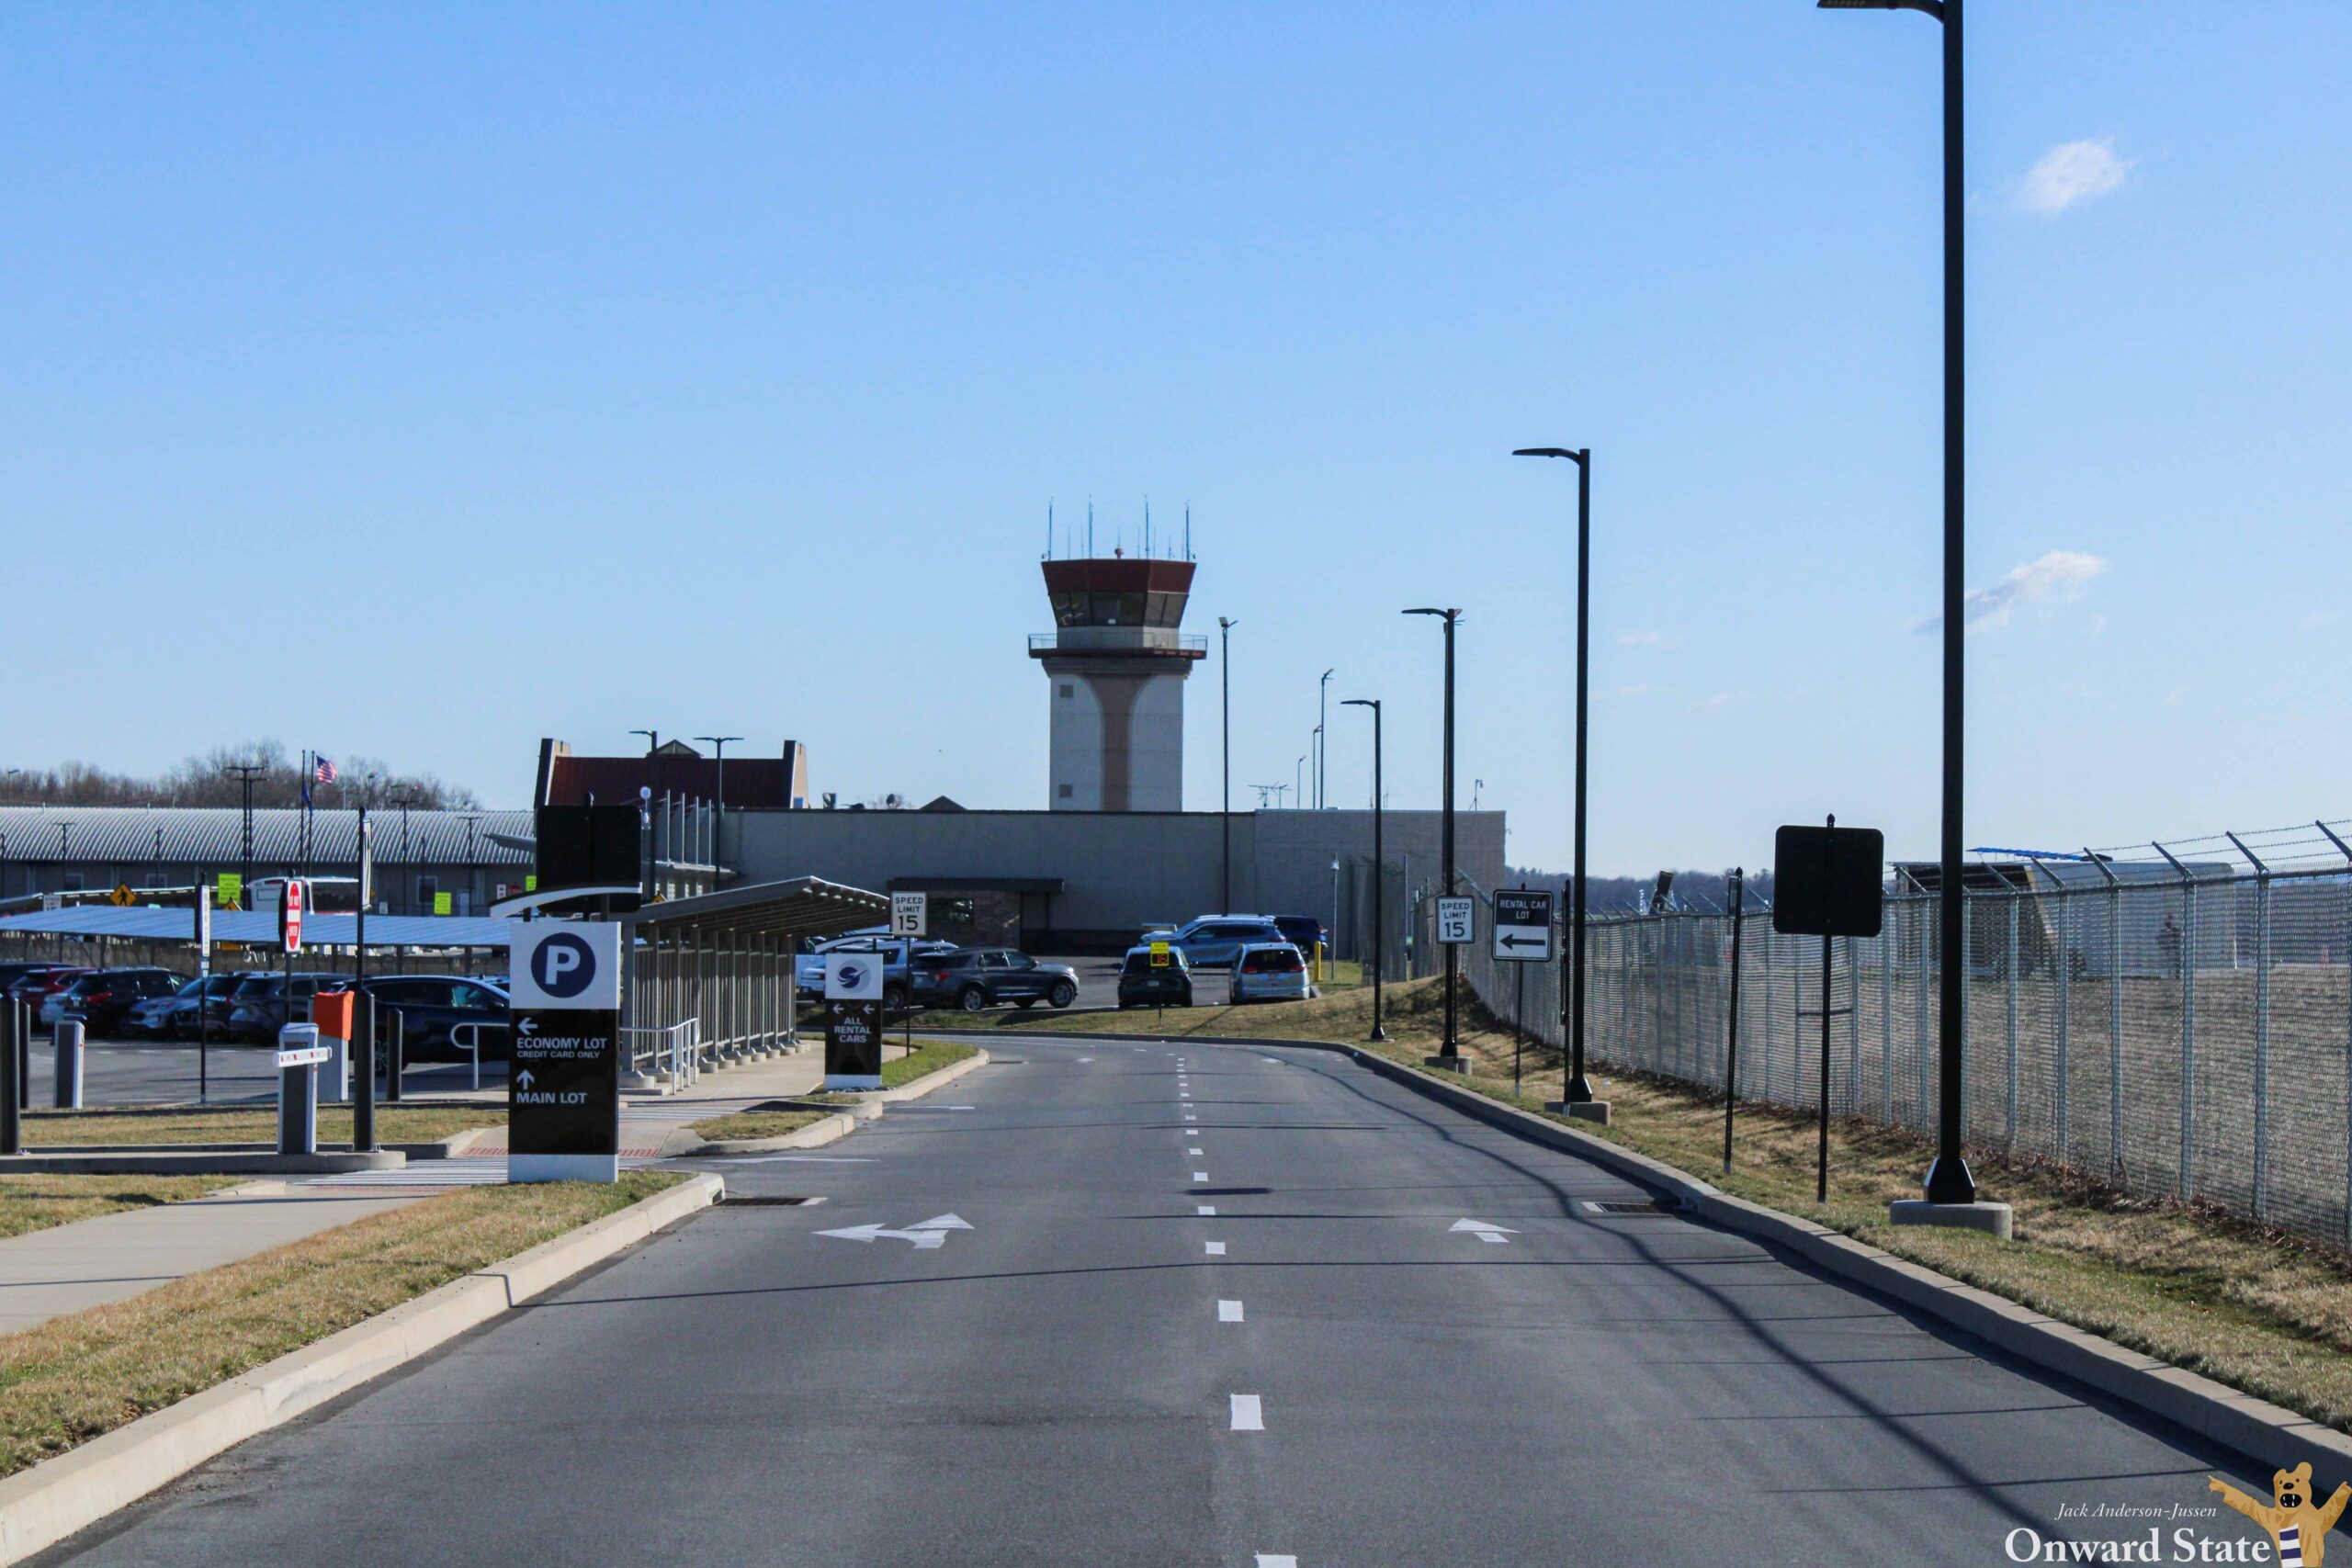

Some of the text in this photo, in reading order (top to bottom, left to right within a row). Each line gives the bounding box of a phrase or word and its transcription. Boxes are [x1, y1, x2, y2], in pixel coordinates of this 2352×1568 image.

[895, 897, 923, 905] SPEED
[1499, 899, 1547, 909] RENTAL CAR
[1441, 902, 1470, 910] SPEED
[1443, 911, 1468, 919] LIMIT
[1516, 910, 1531, 919] LOT
[898, 915, 919, 931] 15
[1444, 921, 1465, 938] 15
[546, 944, 581, 985] P
[843, 1017, 863, 1025] ALL
[833, 1026, 872, 1034] RENTAL
[516, 1037, 608, 1049] ECONOMY LOT
[839, 1034, 867, 1043] CARS
[516, 1050, 601, 1058] CREDIT CARD ONLY
[516, 1092, 587, 1104] MAIN LOT
